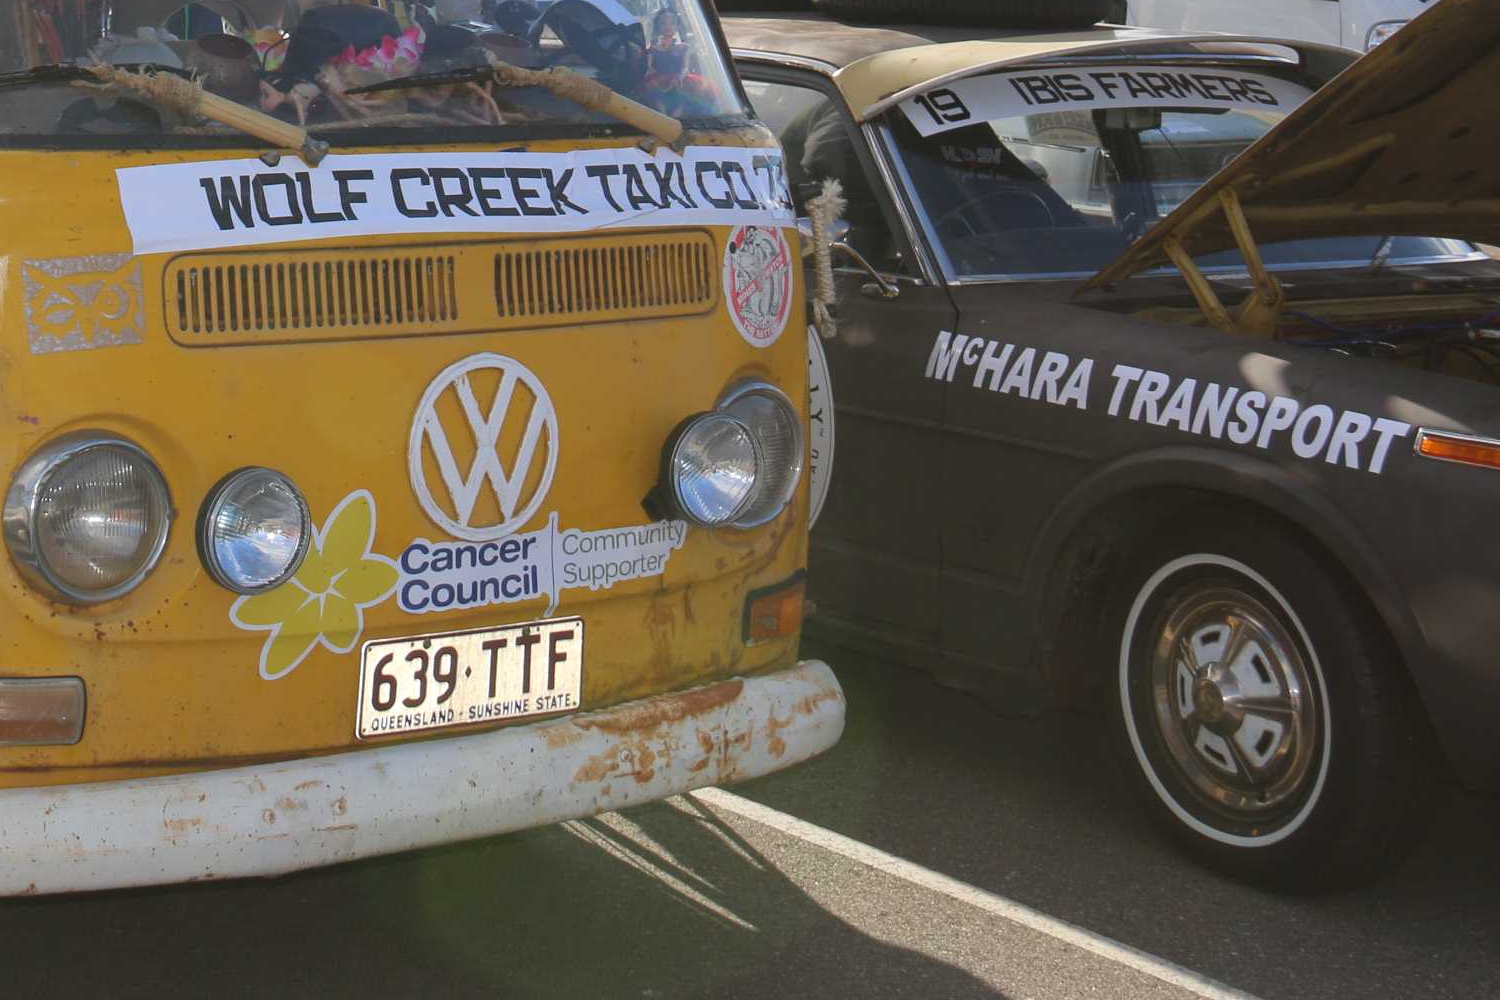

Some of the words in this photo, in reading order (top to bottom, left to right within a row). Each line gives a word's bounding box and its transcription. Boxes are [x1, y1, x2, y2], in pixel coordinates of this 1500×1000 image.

[913, 88, 972, 125] 19
[1009, 73, 1094, 105] IBIS
[1088, 72, 1279, 106] FARMERS
[199, 168, 375, 231] WOLF
[391, 167, 589, 218] CREEK
[585, 162, 699, 212] TAXI
[924, 330, 1095, 410] McHARA
[1107, 364, 1412, 474] TRANSPORT
[401, 535, 537, 575] Cancer
[562, 519, 686, 555] Community
[401, 565, 538, 611] Council
[562, 550, 667, 590] Supporter
[371, 708, 455, 731] QUEENSLAND
[468, 699, 529, 718] SUNSHINE
